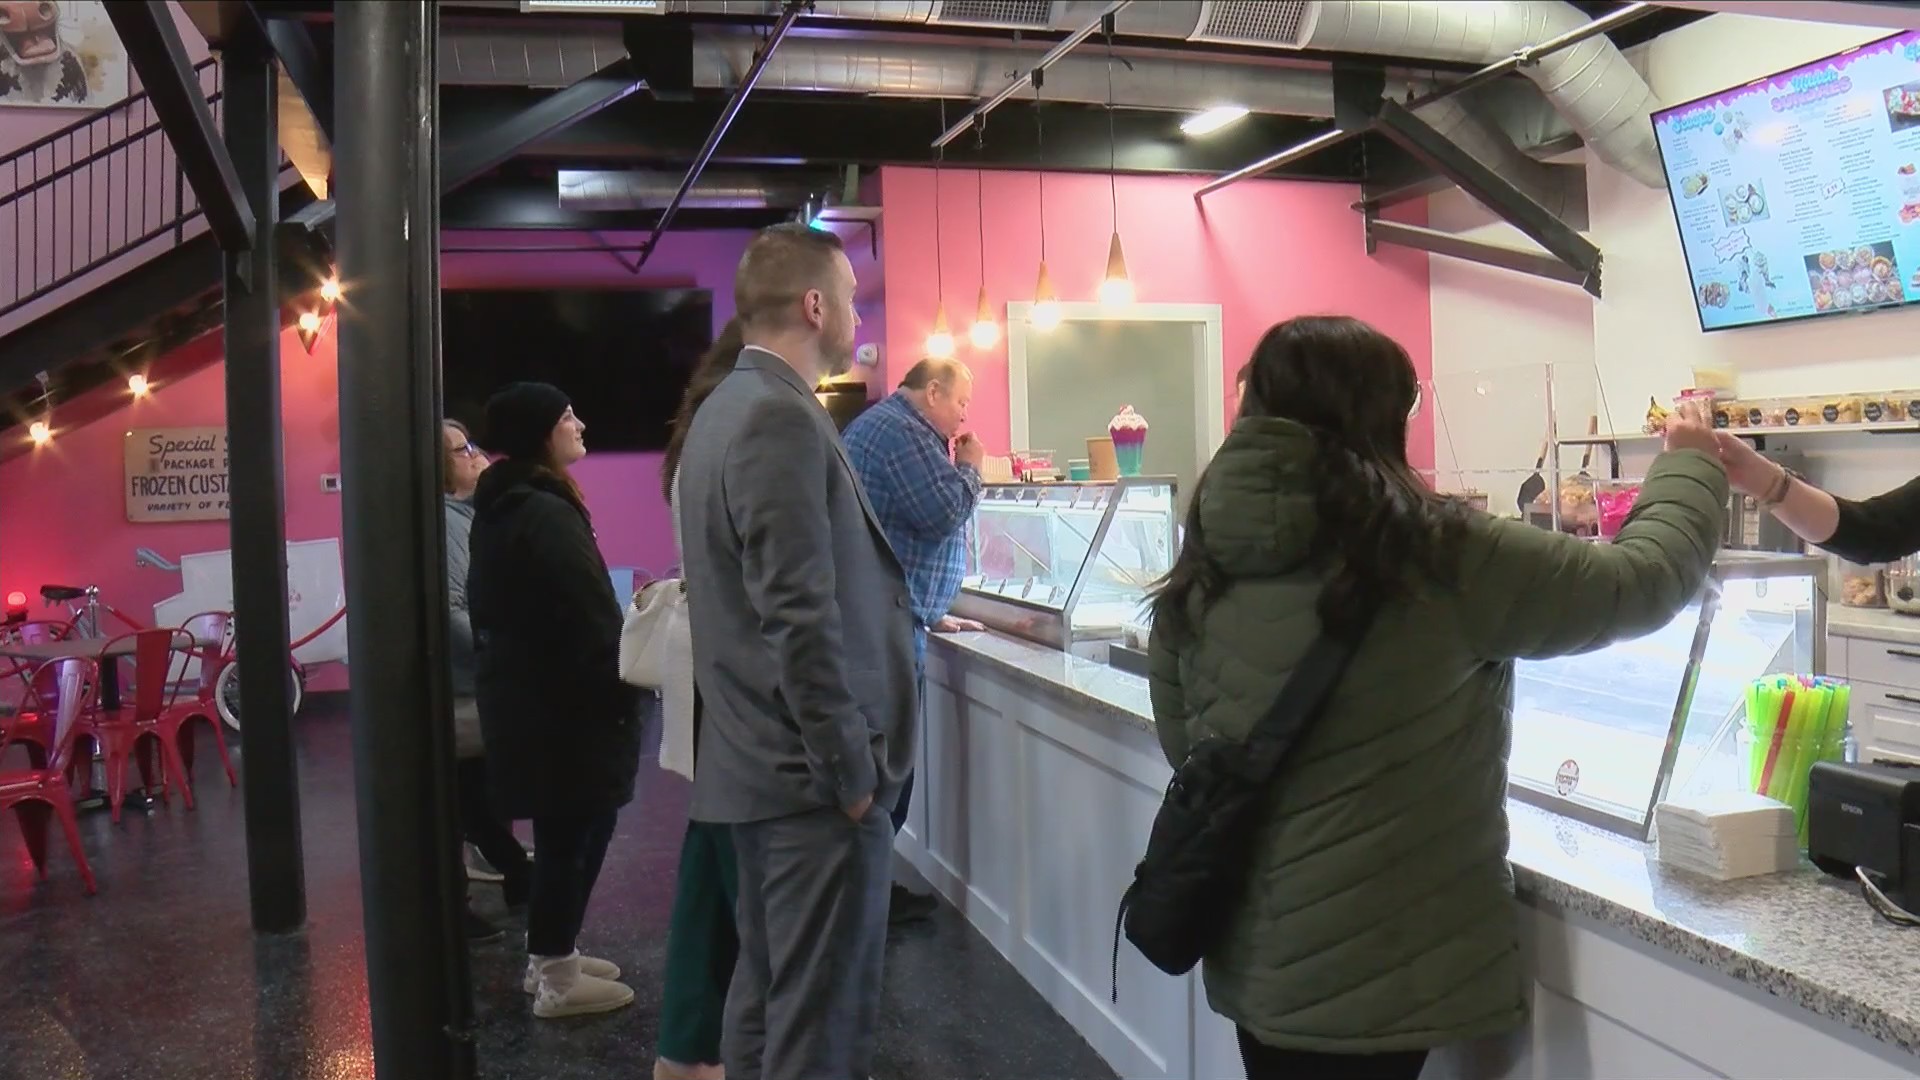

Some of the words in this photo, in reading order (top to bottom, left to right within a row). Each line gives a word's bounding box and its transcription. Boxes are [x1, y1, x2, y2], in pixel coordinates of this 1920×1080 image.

[149, 434, 217, 462] Special
[164, 459, 215, 470] PACKAGE
[131, 475, 187, 496] FROZEN
[189, 474, 229, 495] CUST
[147, 501, 191, 512] VARIETY
[198, 501, 212, 510] OF
